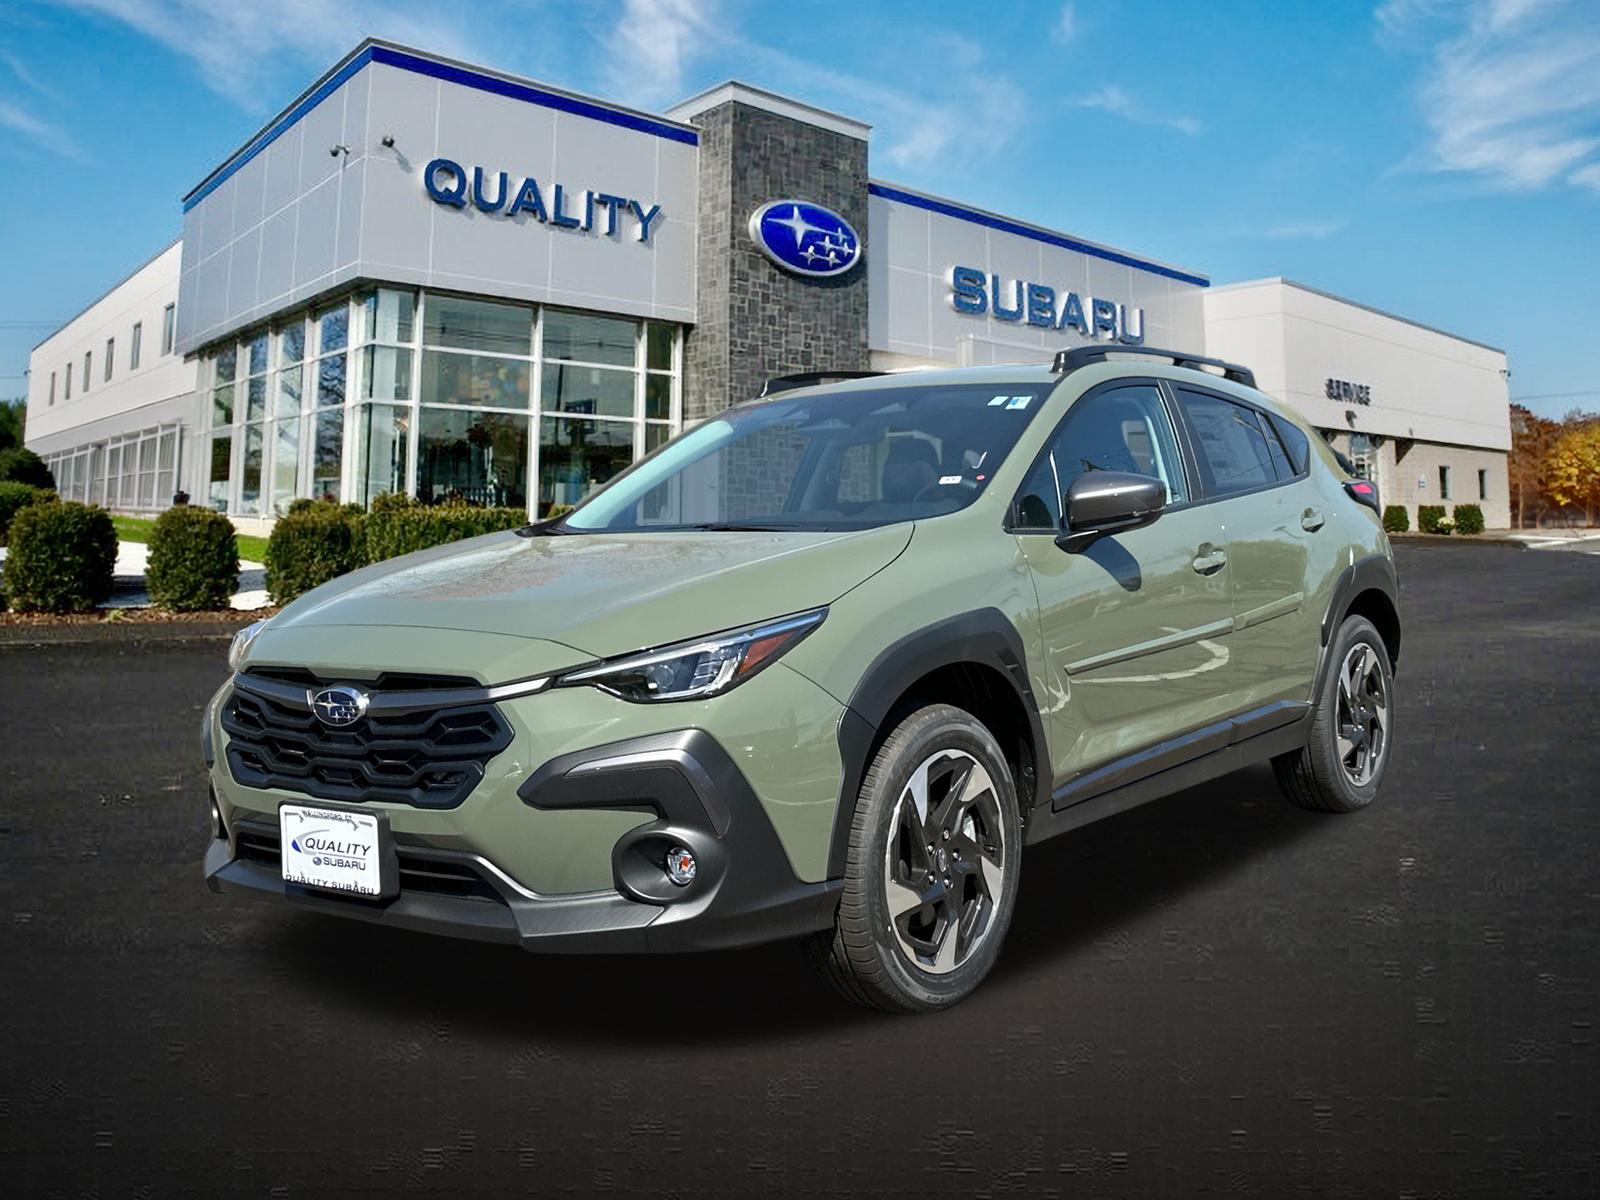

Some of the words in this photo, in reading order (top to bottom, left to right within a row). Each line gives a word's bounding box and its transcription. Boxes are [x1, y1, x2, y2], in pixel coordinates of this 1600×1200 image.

[424, 158, 660, 242] QUALITY
[951, 265, 1145, 345] SUBARU
[305, 838, 371, 856] QUALITY
[323, 857, 366, 870] SUBARU
[285, 873, 329, 888] QUALITY
[331, 881, 374, 895] SUBARU
